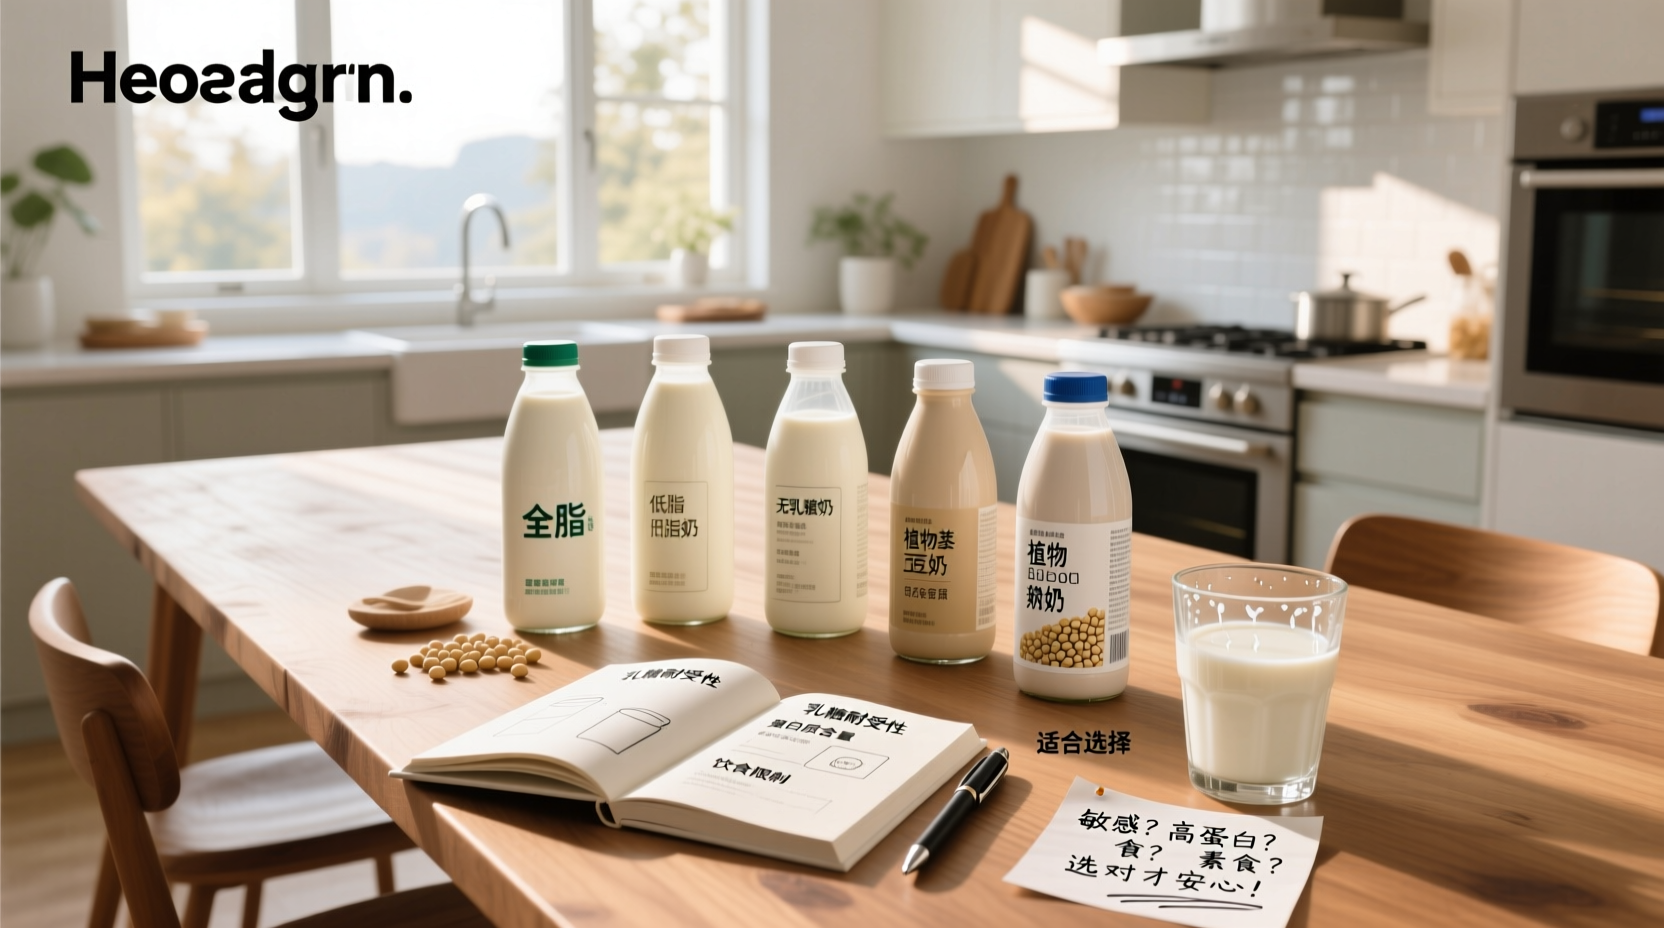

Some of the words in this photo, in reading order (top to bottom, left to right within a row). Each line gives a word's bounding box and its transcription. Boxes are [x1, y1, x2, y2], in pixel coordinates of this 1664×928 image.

[650, 494, 685, 514] 低脂
[522, 502, 586, 539] 全脂
[1027, 539, 1068, 568] 植物
